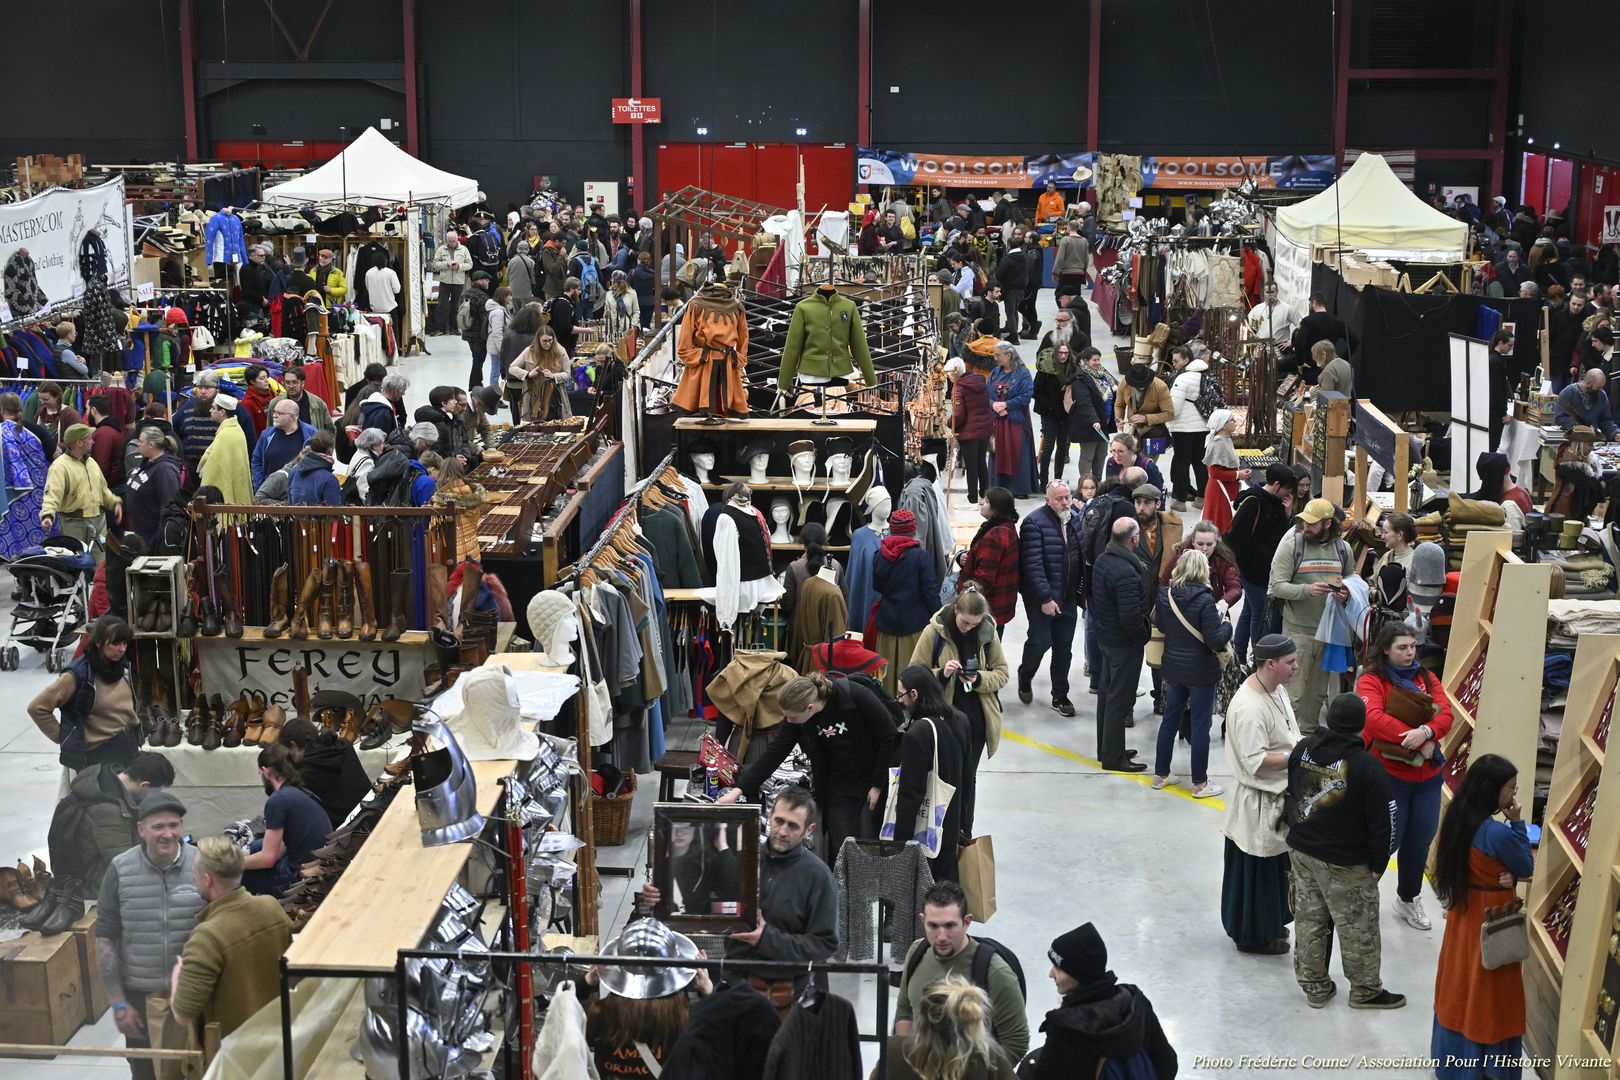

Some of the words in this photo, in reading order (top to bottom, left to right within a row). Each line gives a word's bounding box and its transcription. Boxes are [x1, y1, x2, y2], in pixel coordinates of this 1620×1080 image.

[617, 105, 656, 113] TOILETTES
[900, 157, 1040, 175] WOOLSOME
[1141, 161, 1283, 177] WOOLSOME
[235, 646, 400, 687] FEREY
